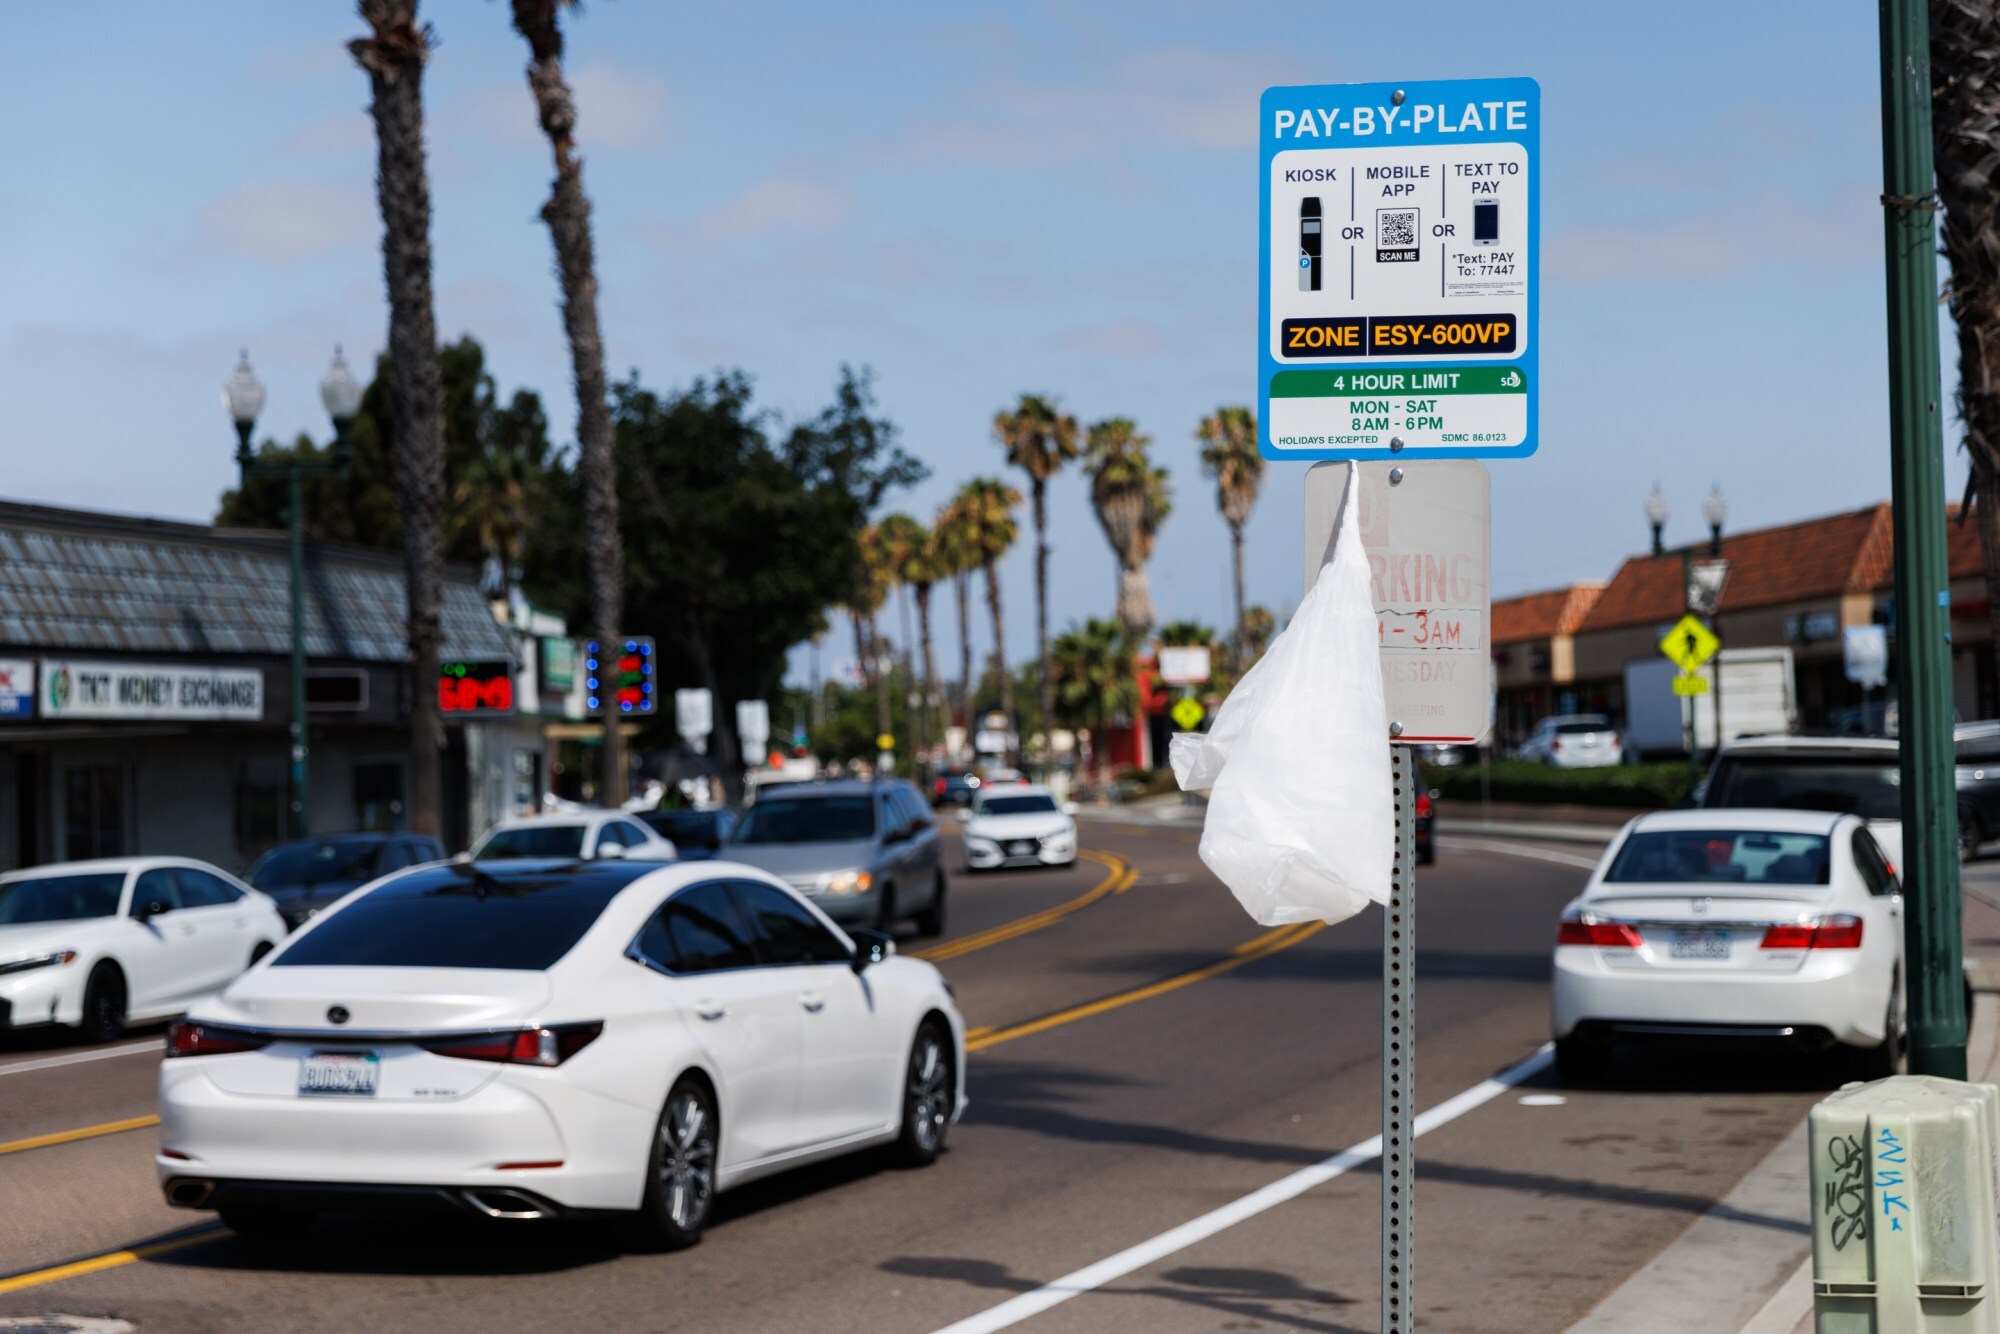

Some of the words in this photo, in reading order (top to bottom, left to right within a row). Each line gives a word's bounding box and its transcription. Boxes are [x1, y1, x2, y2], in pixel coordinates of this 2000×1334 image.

[1274, 101, 1528, 138] PAY-BY-PLATE
[1285, 168, 1337, 182] KIOSK
[1366, 165, 1430, 180] MOBILE
[1454, 163, 1493, 176] TEXT
[1499, 162, 1519, 175] TO
[1381, 184, 1415, 197] APP
[1471, 181, 1501, 194] PAY
[1341, 227, 1365, 240] OR
[1432, 224, 1456, 237] OR
[1379, 252, 1403, 261] SCAN
[1404, 252, 1416, 260] ME
[1490, 252, 1515, 263] PAY
[1457, 265, 1477, 276] To:
[1480, 264, 1516, 276] 77447
[1288, 326, 1360, 348] ZONE
[1374, 322, 1510, 347] ESY-600VP
[1333, 376, 1345, 390] 4
[1351, 374, 1405, 390] HOUR
[1411, 373, 1461, 389] LIMIT
[1350, 401, 1390, 414] MON
[1405, 400, 1438, 414] SAT
[1279, 436, 1326, 445] HOLIDAYS
[1328, 435, 1379, 444] EXCEPTED
[1441, 434, 1470, 442] SDMC
[1472, 433, 1507, 442] 86.0123
[1369, 553, 1472, 602] RKING
[1413, 610, 1461, 644] 3AM
[1382, 660, 1456, 682] NESDAY
